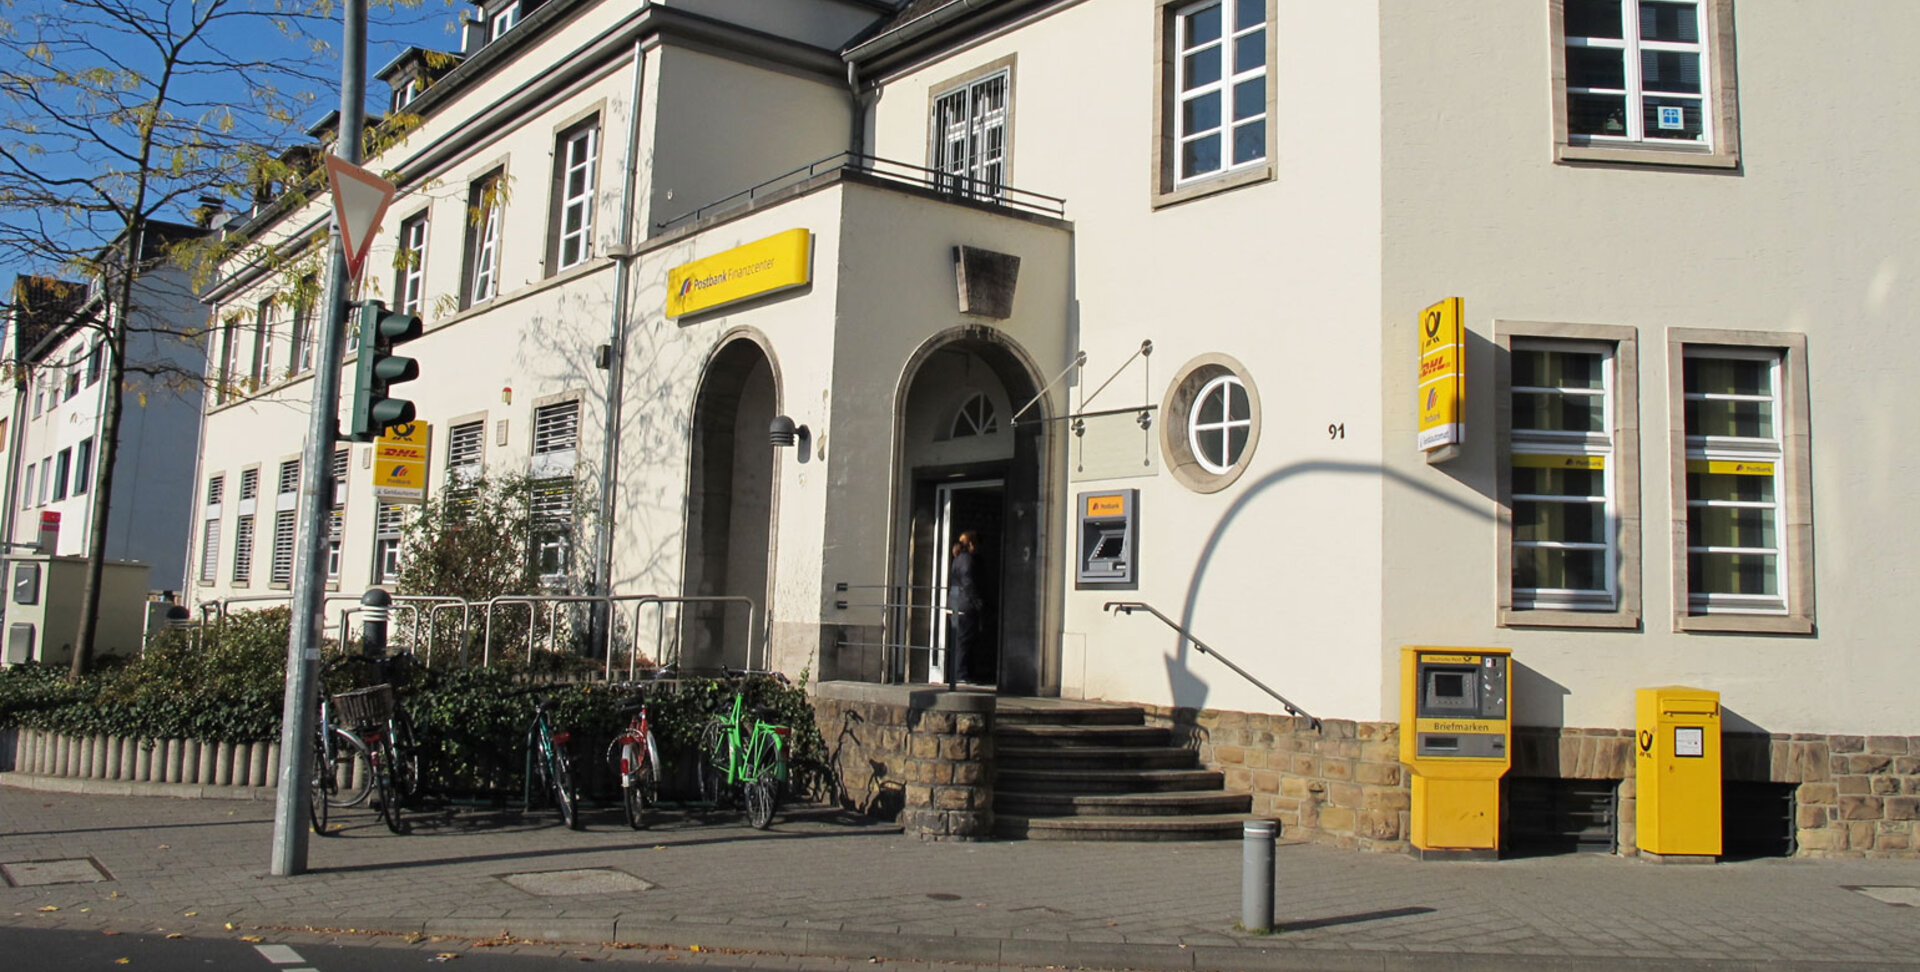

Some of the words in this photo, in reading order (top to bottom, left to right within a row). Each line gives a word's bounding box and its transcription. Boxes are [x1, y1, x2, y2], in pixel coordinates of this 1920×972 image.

[693, 270, 728, 291] Postbank
[727, 257, 775, 280] Finanzcenter
[1328, 422, 1345, 440] 91
[383, 448, 419, 458] DHL
[1434, 722, 1490, 731] Briefmarken
